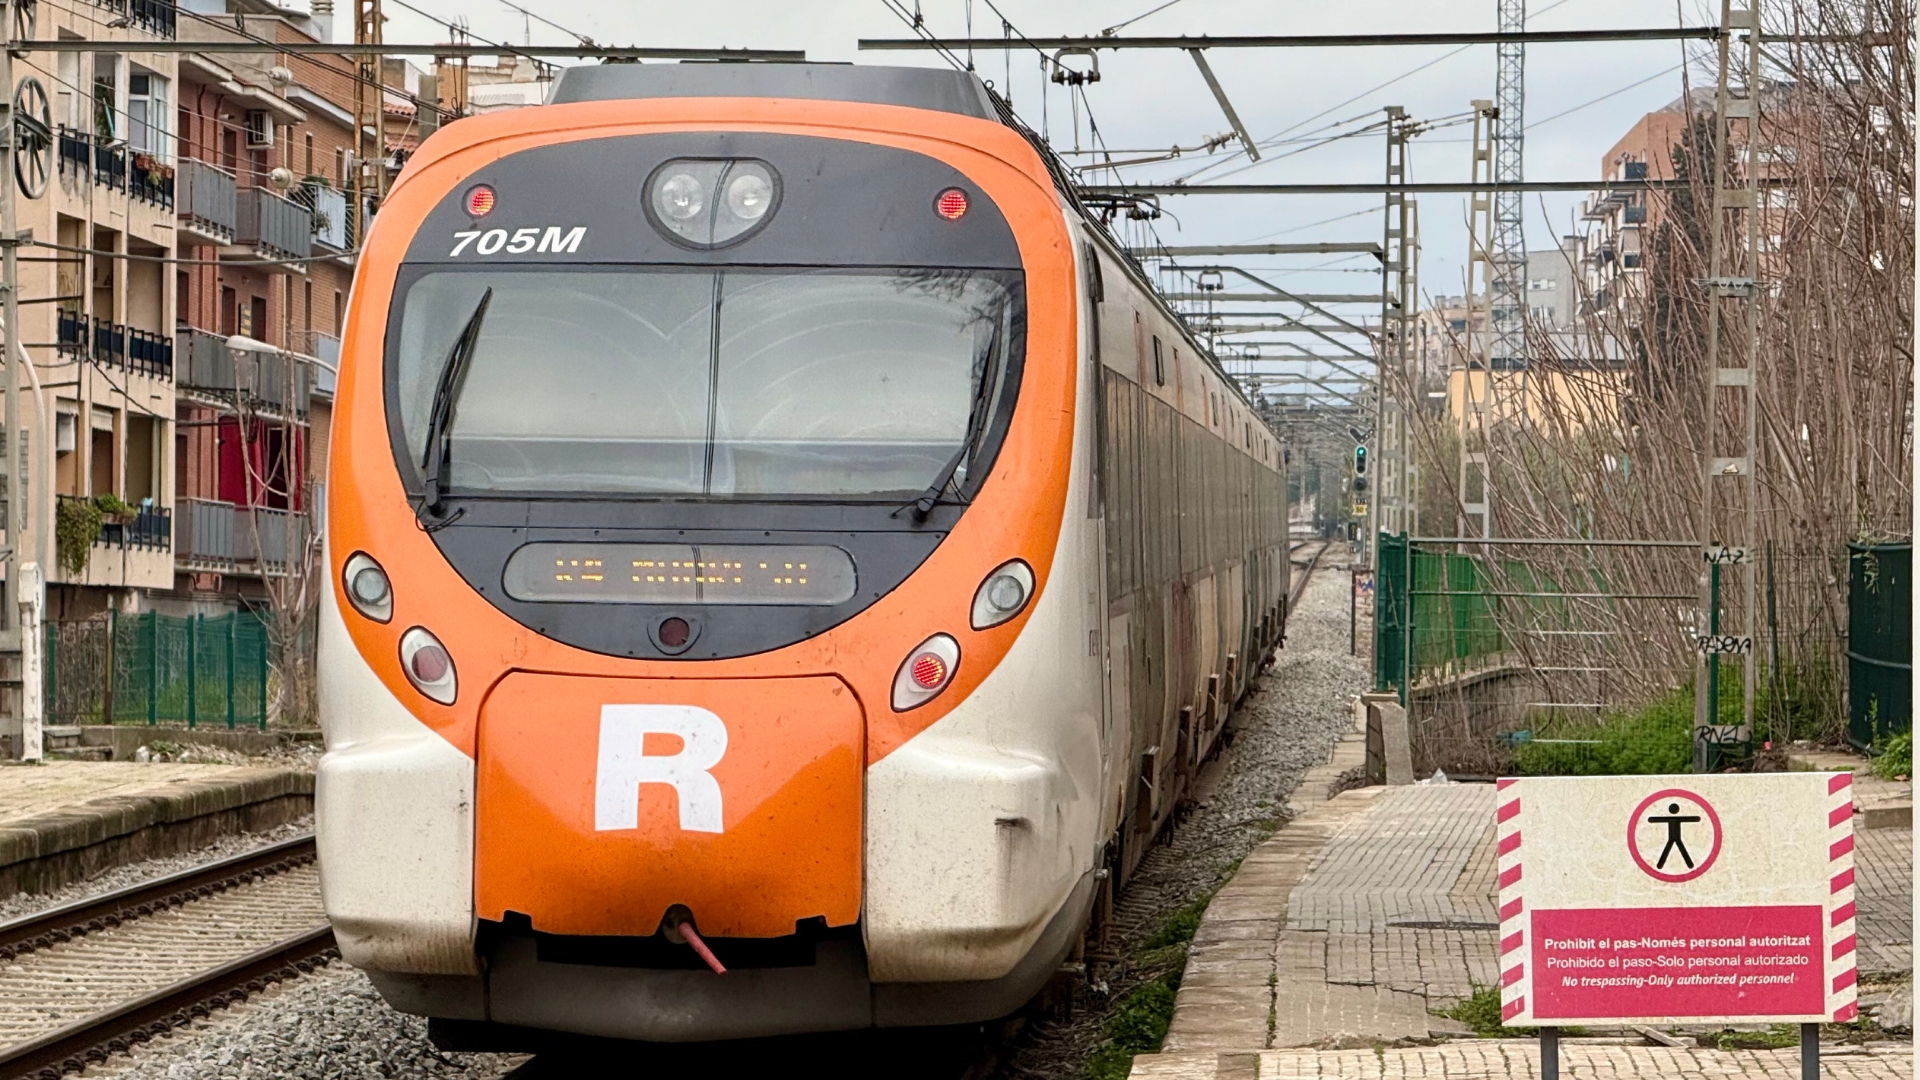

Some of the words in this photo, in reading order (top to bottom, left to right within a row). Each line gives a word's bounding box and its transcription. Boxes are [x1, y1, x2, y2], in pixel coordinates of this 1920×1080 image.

[449, 226, 587, 257] 705M
[594, 704, 728, 833] R
[1544, 938, 1596, 950] Prohibit
[1598, 938, 1610, 949] el
[1613, 936, 1687, 951] pas-Només
[1689, 935, 1746, 950] personal
[1749, 934, 1811, 947] autoritzat
[1547, 957, 1605, 968] Prohibido
[1608, 956, 1620, 968] el
[1622, 955, 1685, 970] paso-Solo
[1688, 954, 1741, 969] personal
[1744, 953, 1809, 966] autorizado
[1562, 976, 1578, 987] No
[1581, 974, 1674, 988] trespassing-Only
[1676, 973, 1737, 985] authorized
[1739, 972, 1795, 987] personnel
